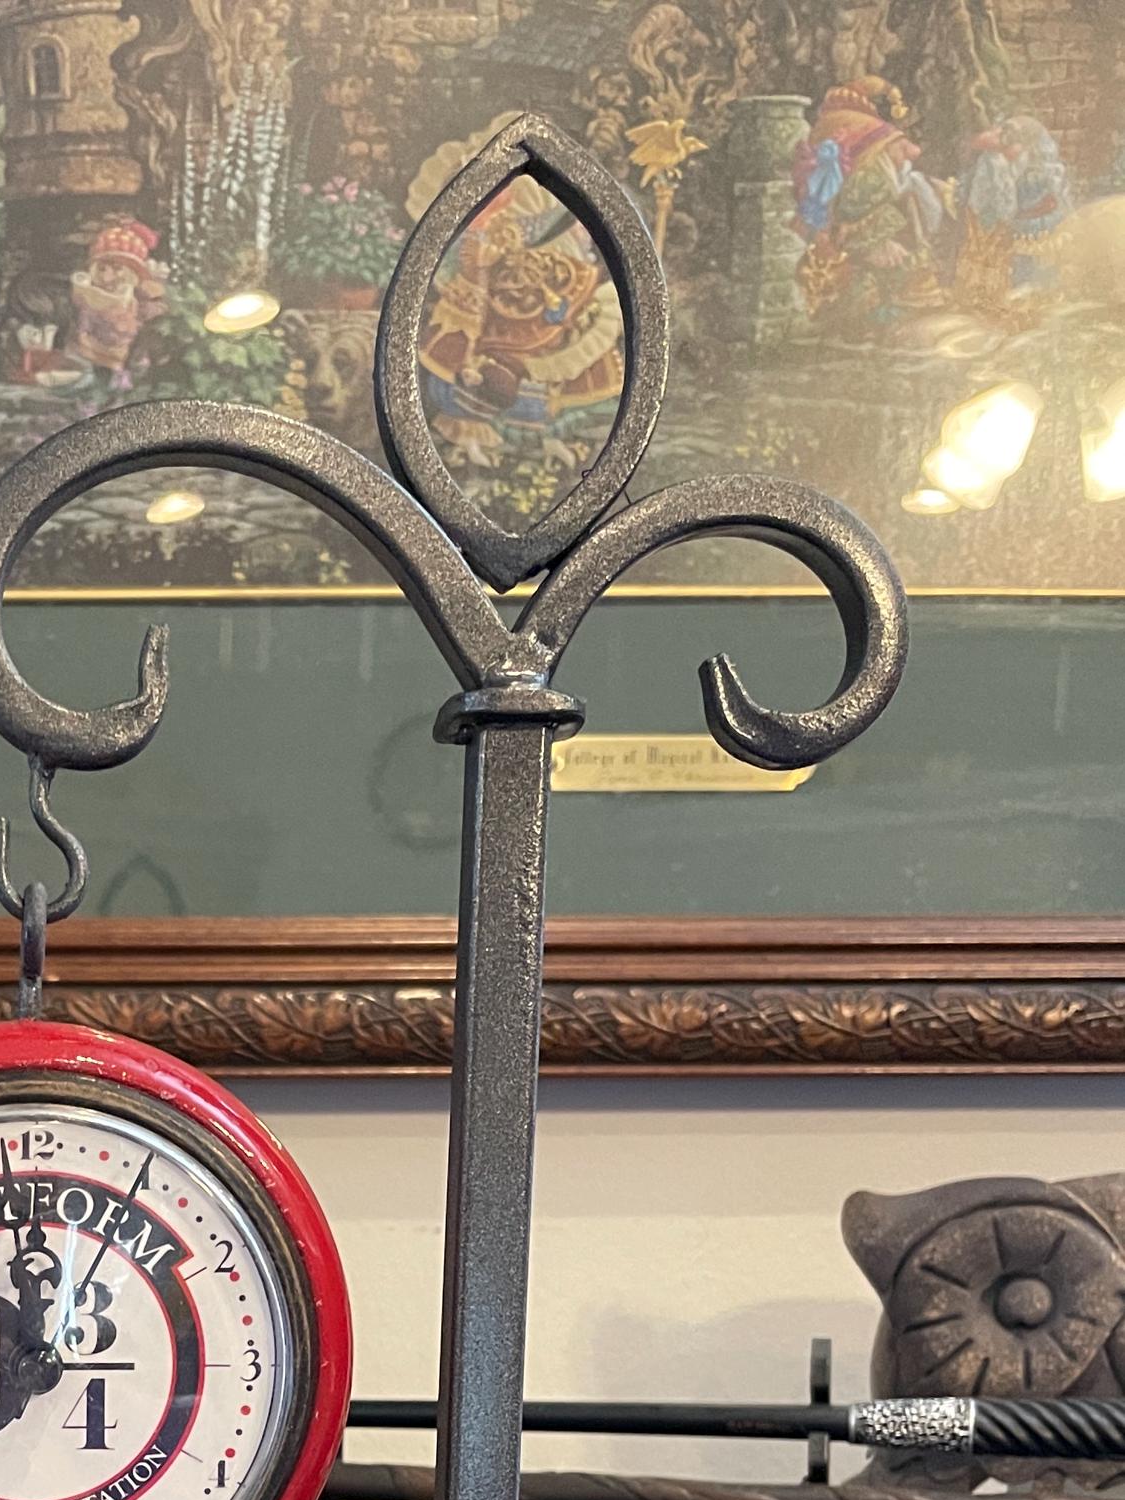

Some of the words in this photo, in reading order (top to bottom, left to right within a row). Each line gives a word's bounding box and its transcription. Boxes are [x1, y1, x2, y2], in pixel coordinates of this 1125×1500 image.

[20, 1129, 55, 1160] 12
[214, 1240, 236, 1273] 2
[64, 1280, 117, 1355] 3
[240, 1349, 262, 1382] 3
[62, 1378, 118, 1450] 4
[208, 1460, 230, 1488] 4
